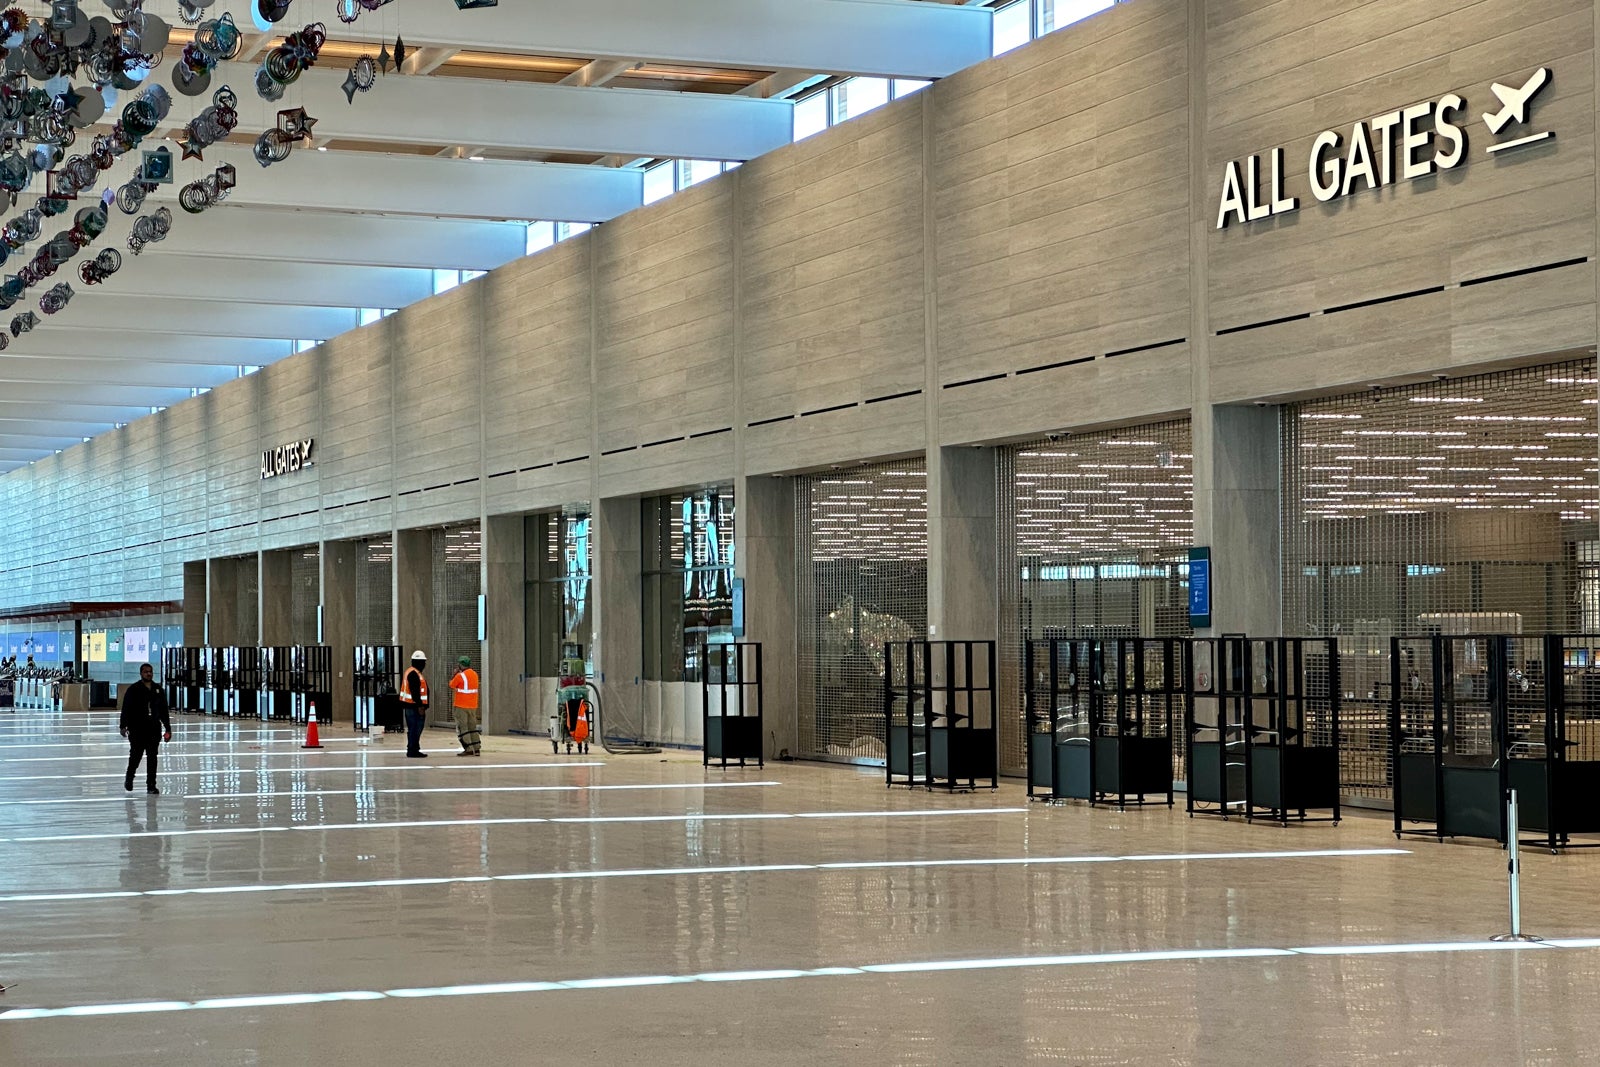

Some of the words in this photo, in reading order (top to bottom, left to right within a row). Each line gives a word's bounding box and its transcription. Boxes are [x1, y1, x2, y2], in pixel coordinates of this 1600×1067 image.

[1217, 147, 1298, 229] ALL
[1309, 94, 1467, 202] GATES
[260, 449, 275, 480] ALL
[275, 441, 300, 475] GATES
